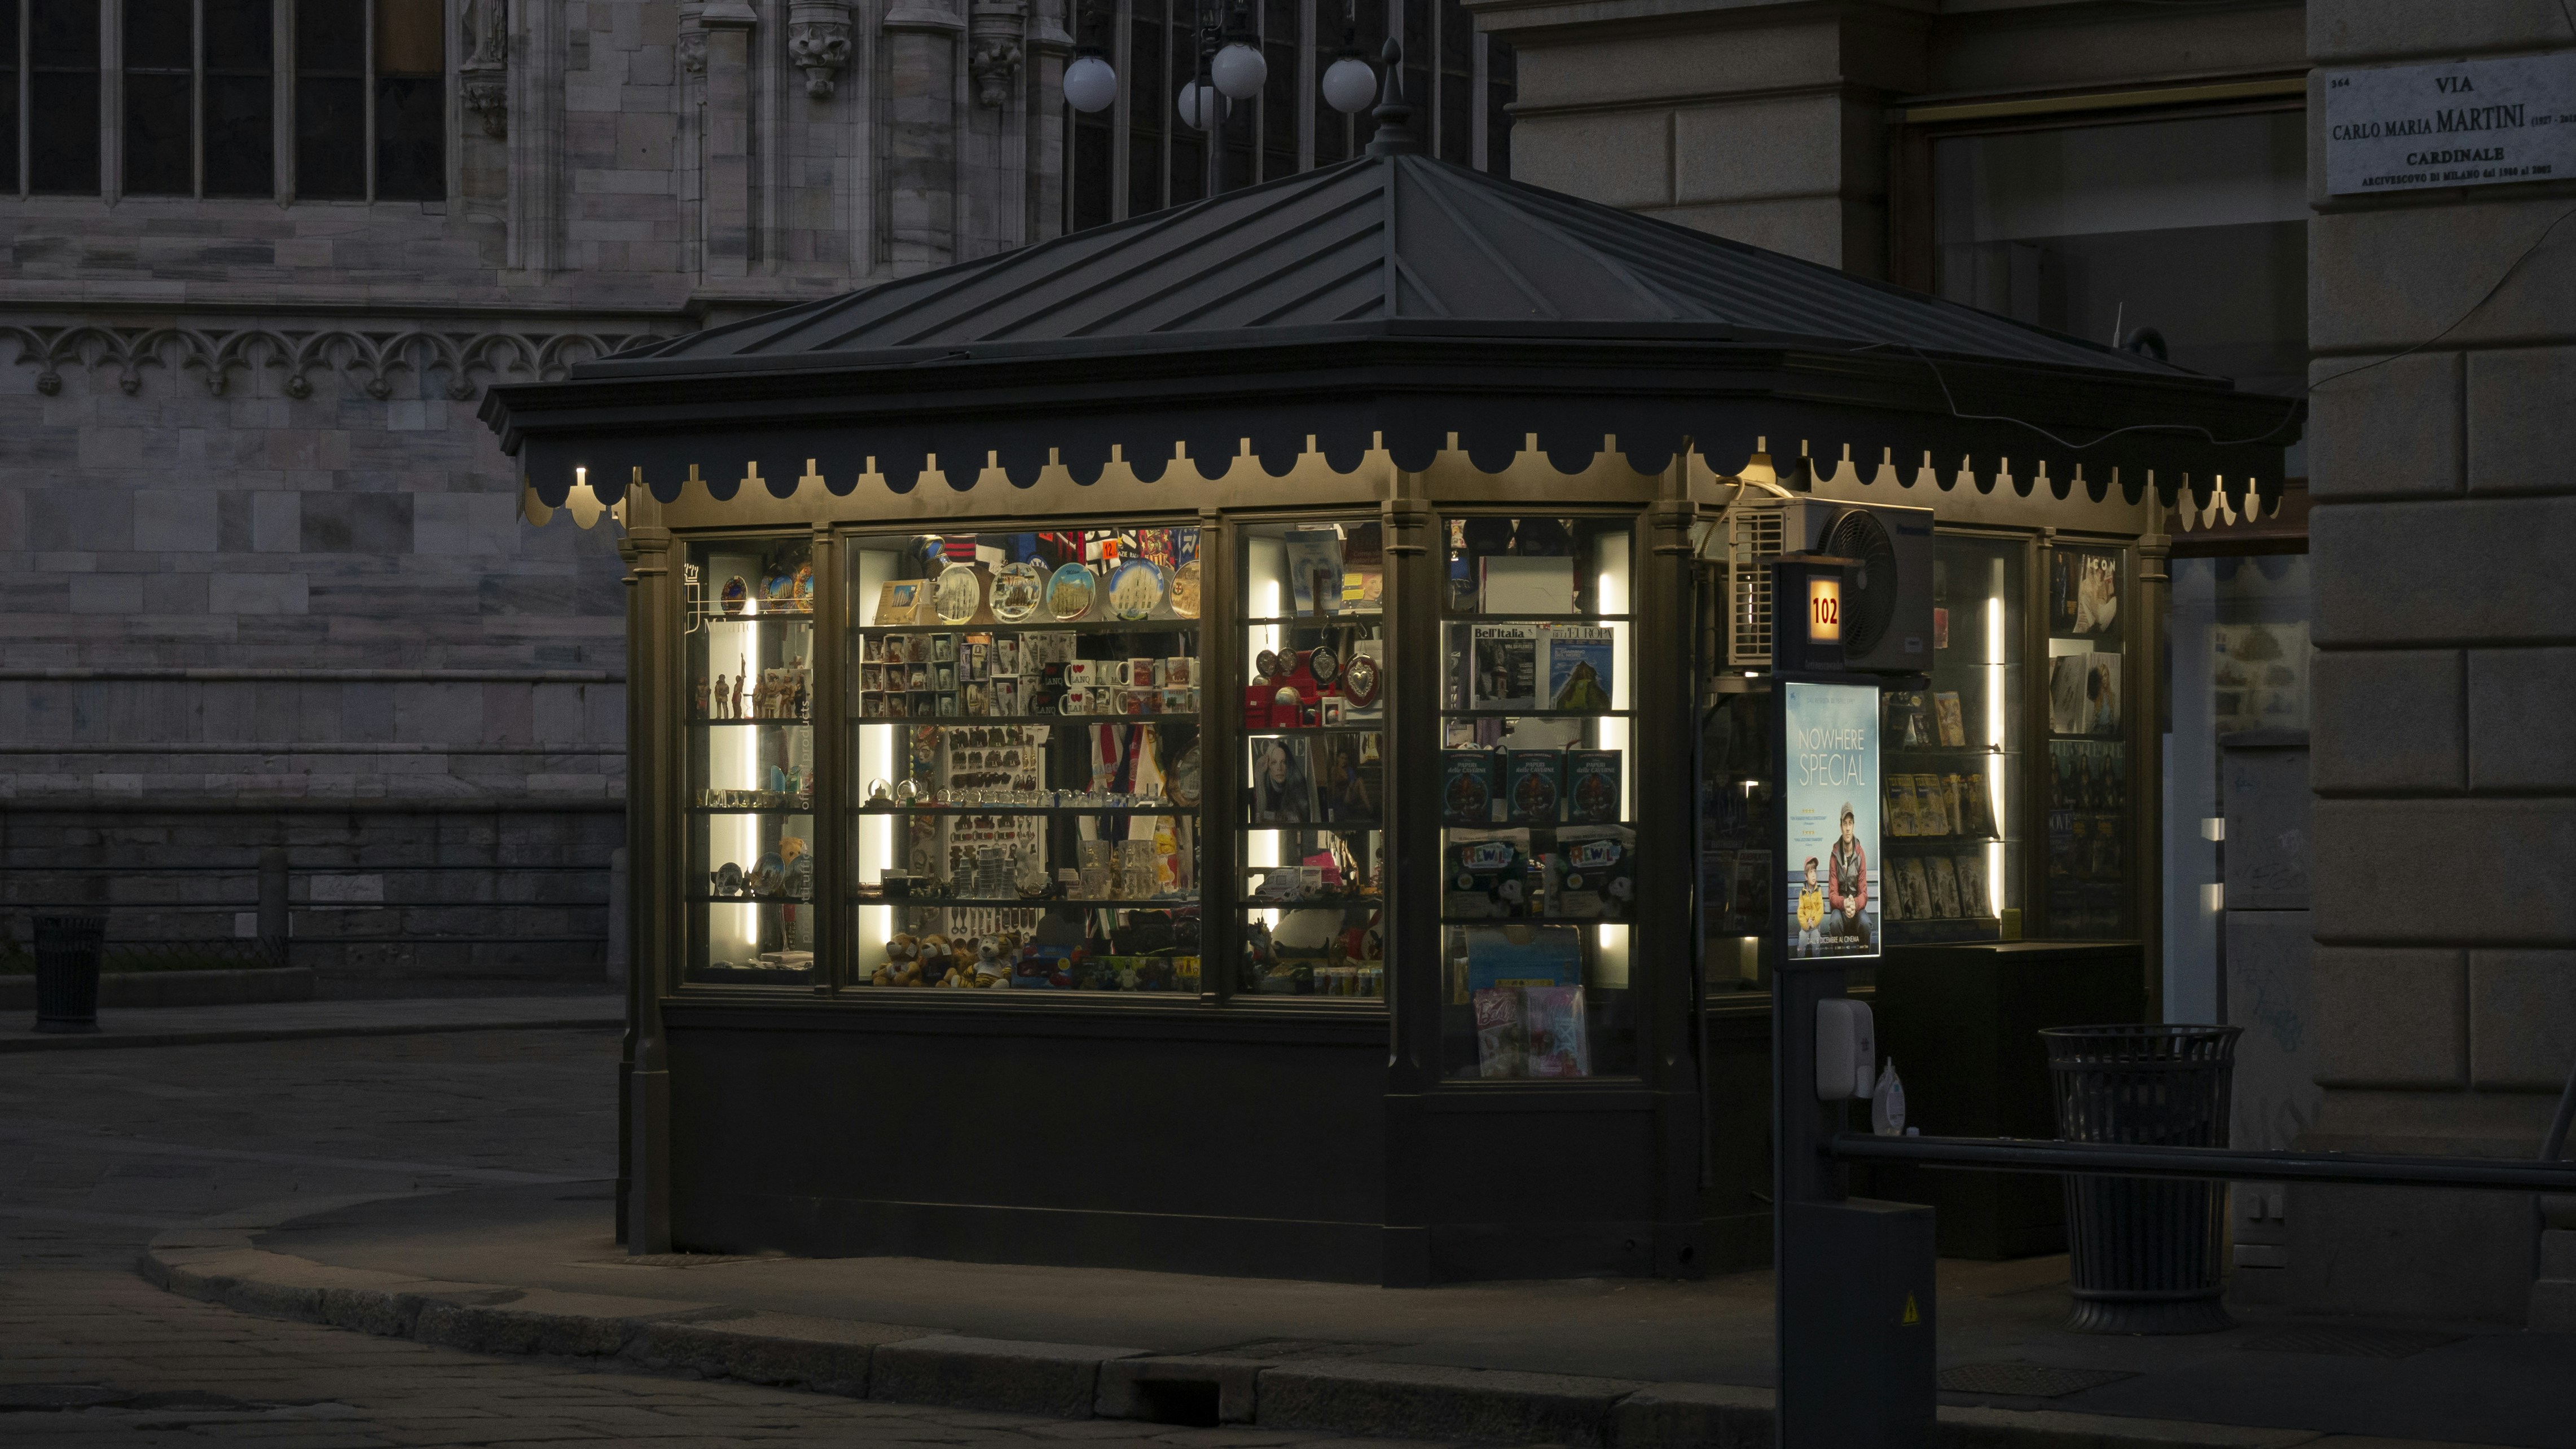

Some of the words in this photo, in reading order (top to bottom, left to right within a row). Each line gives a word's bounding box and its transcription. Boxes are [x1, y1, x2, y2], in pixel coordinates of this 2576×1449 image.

[2331, 78, 2350, 89] 364
[2436, 76, 2474, 94] VIA
[2332, 121, 2381, 141] CARLO
[2385, 118, 2433, 137] MARIA
[2436, 103, 2525, 134] MARTINI
[2407, 147, 2505, 166] CARDINALE
[2362, 173, 2426, 187] ARCIVESCOVO
[2430, 171, 2440, 181] DI
[2443, 170, 2480, 180] MILANO
[2483, 168, 2495, 178] dal
[2521, 166, 2529, 176] al
[2088, 557, 2116, 571] ICON
[1813, 597, 1838, 624] 102
[1475, 628, 1524, 638] Bell'Italia
[799, 701, 813, 762] products
[1799, 728, 1865, 751] NOWHERE
[1252, 739, 1305, 757] VOE
[1799, 753, 1865, 786] SPECIAL
